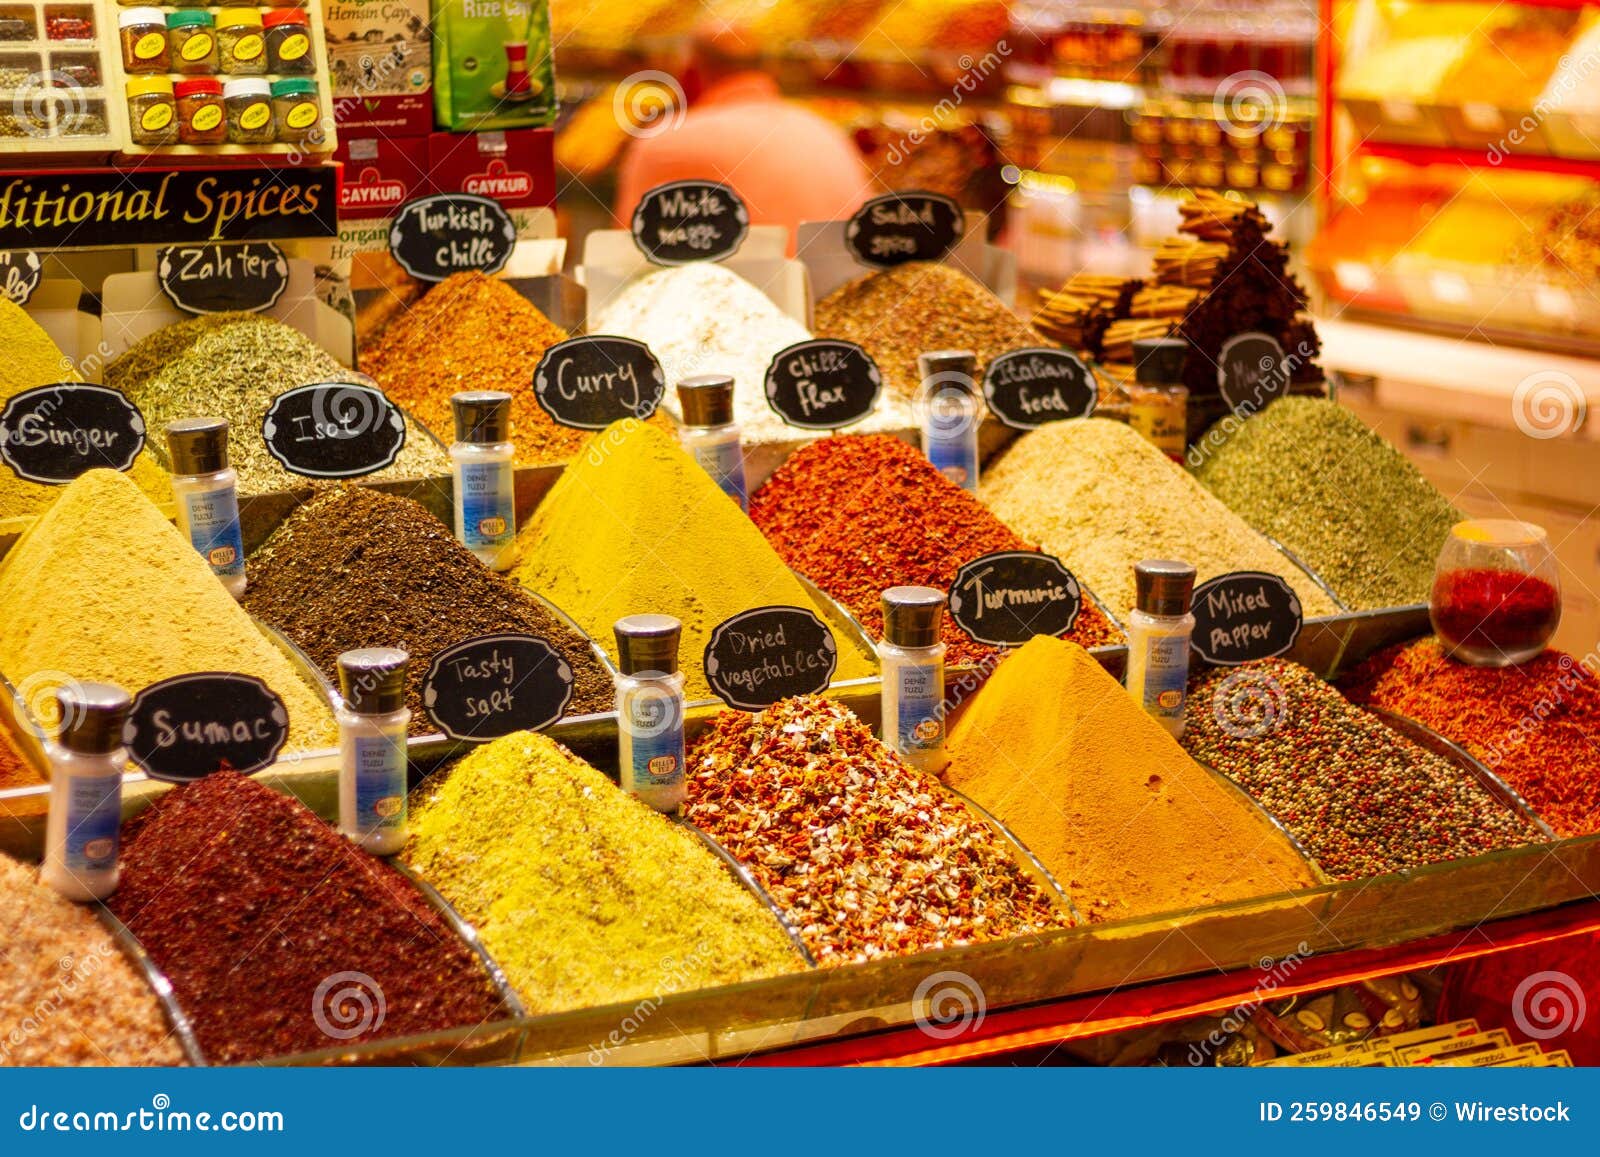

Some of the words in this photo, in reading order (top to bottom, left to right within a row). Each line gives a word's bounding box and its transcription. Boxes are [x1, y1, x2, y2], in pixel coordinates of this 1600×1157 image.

[183, 175, 322, 240] Spices
[412, 203, 494, 234] Turkish
[659, 189, 727, 218] White
[340, 228, 389, 246] organ
[557, 357, 640, 410] Curry
[996, 356, 1075, 386] Italian
[18, 413, 119, 456] Ginger
[291, 412, 359, 442] Isot
[1208, 586, 1271, 619] Mixed
[729, 623, 787, 655] Dried
[447, 649, 514, 684] Tasty
[722, 648, 830, 692] vegetables
[152, 710, 271, 747] Sumac
